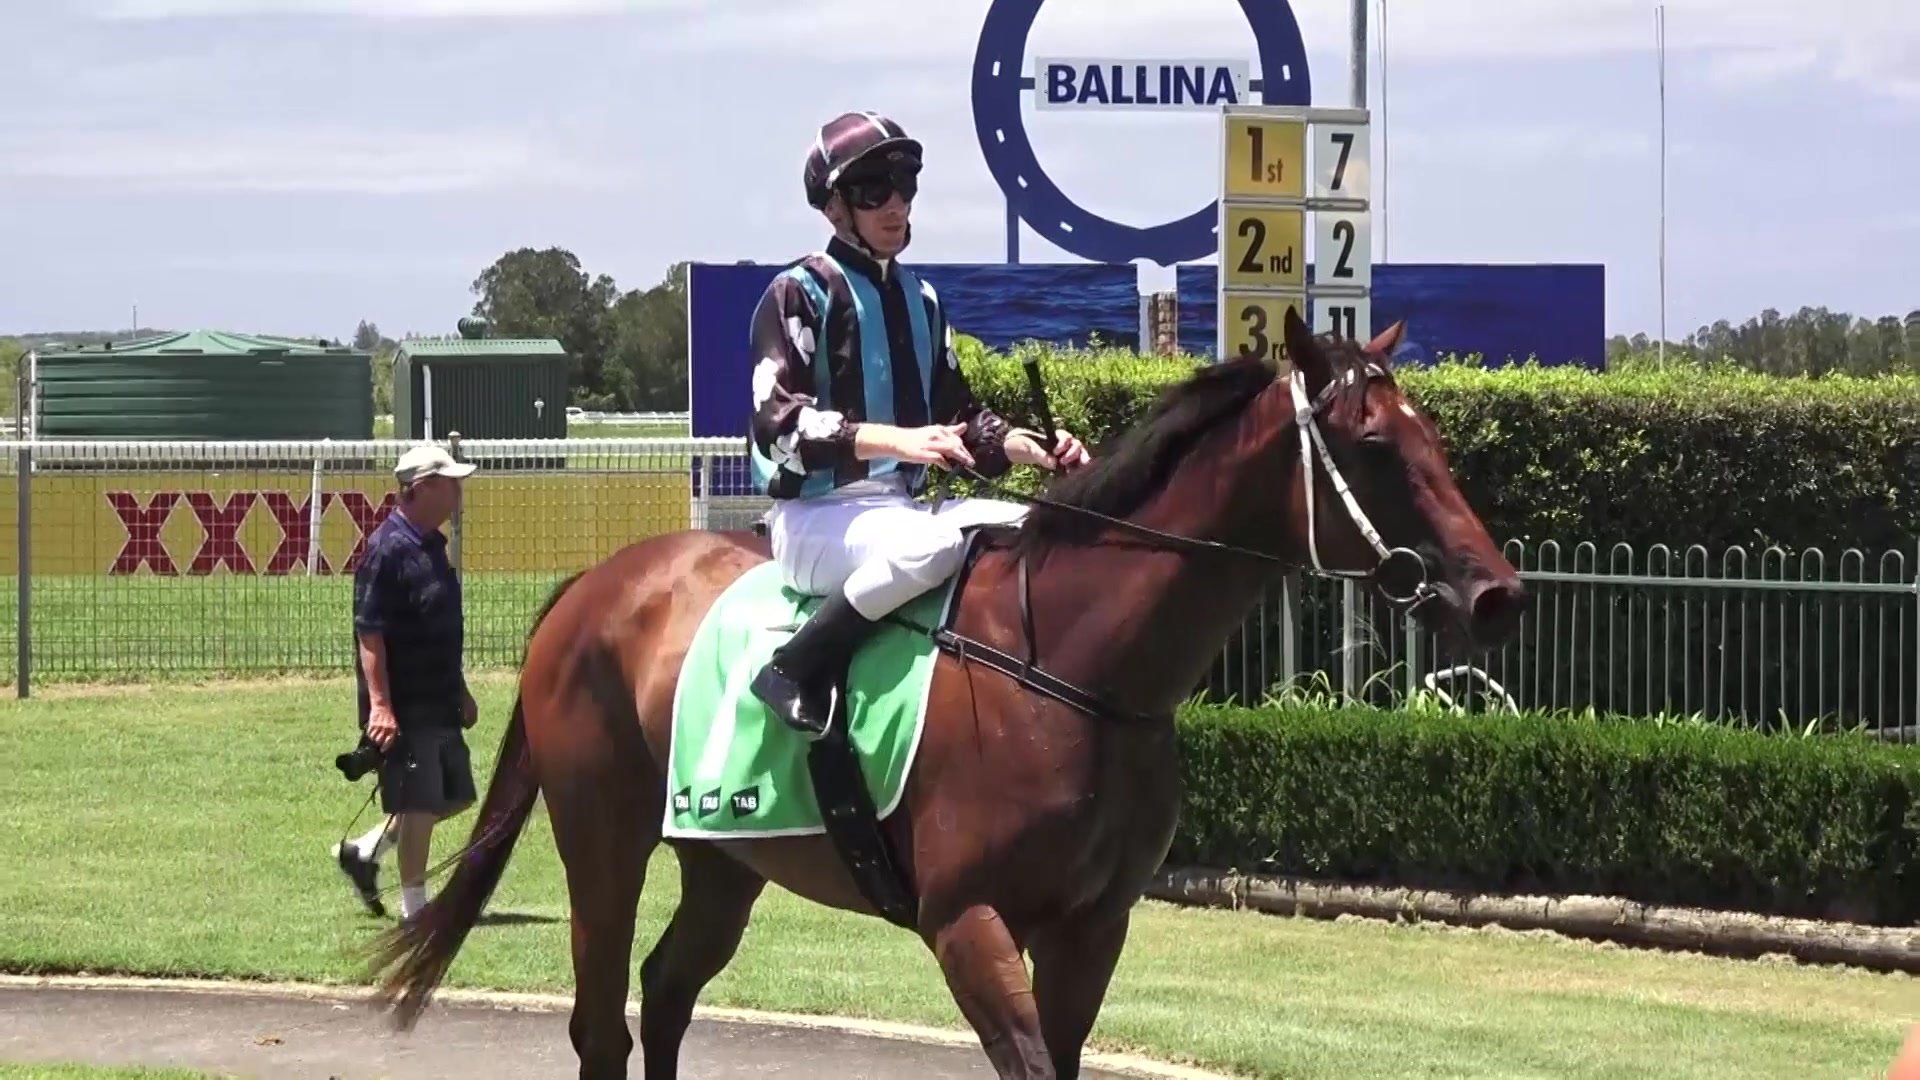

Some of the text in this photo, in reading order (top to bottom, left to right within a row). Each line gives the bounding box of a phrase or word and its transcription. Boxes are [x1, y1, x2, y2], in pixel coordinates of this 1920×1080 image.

[1047, 64, 1239, 105] BALLINA
[1247, 126, 1354, 190] 1st 7
[1237, 217, 1355, 278] 2nd 2
[733, 795, 757, 810] TAB
